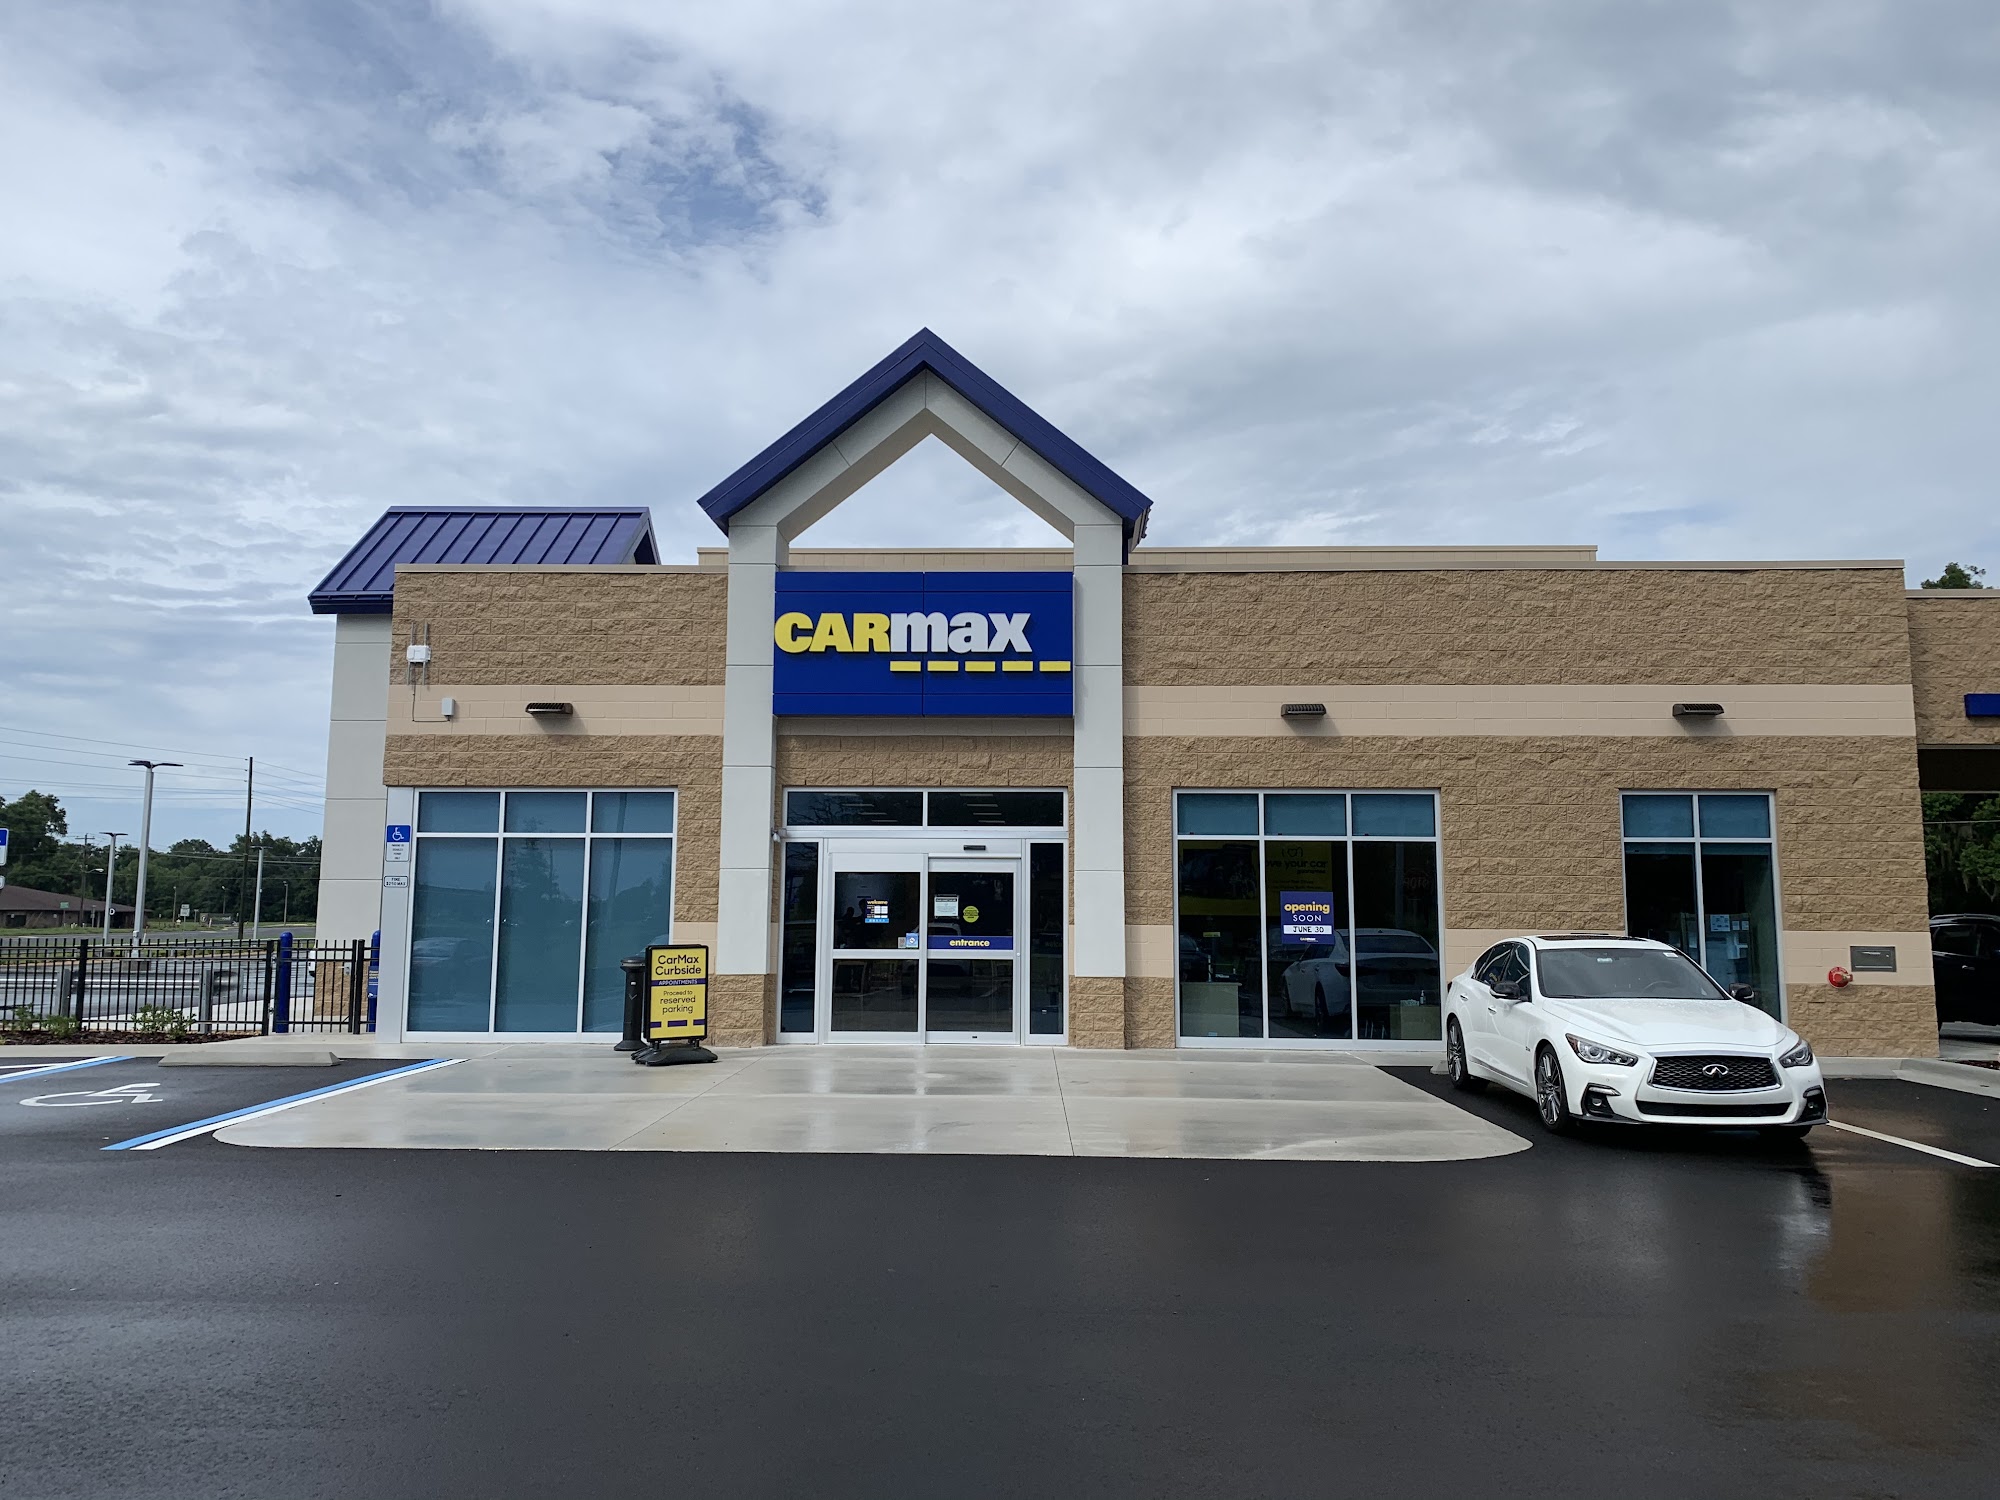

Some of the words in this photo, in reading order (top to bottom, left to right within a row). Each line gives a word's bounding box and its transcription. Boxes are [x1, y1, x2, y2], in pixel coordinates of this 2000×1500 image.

[774, 611, 1033, 653] CARmax
[1284, 860, 1308, 870] your
[1309, 860, 1328, 868] car
[1284, 901, 1330, 914] opening
[1292, 914, 1322, 922] SOON
[949, 939, 990, 947] entrance
[658, 955, 699, 964] CarMax
[655, 965, 701, 975] Curbside
[660, 995, 696, 1004] reserved
[662, 1005, 693, 1015] parking
